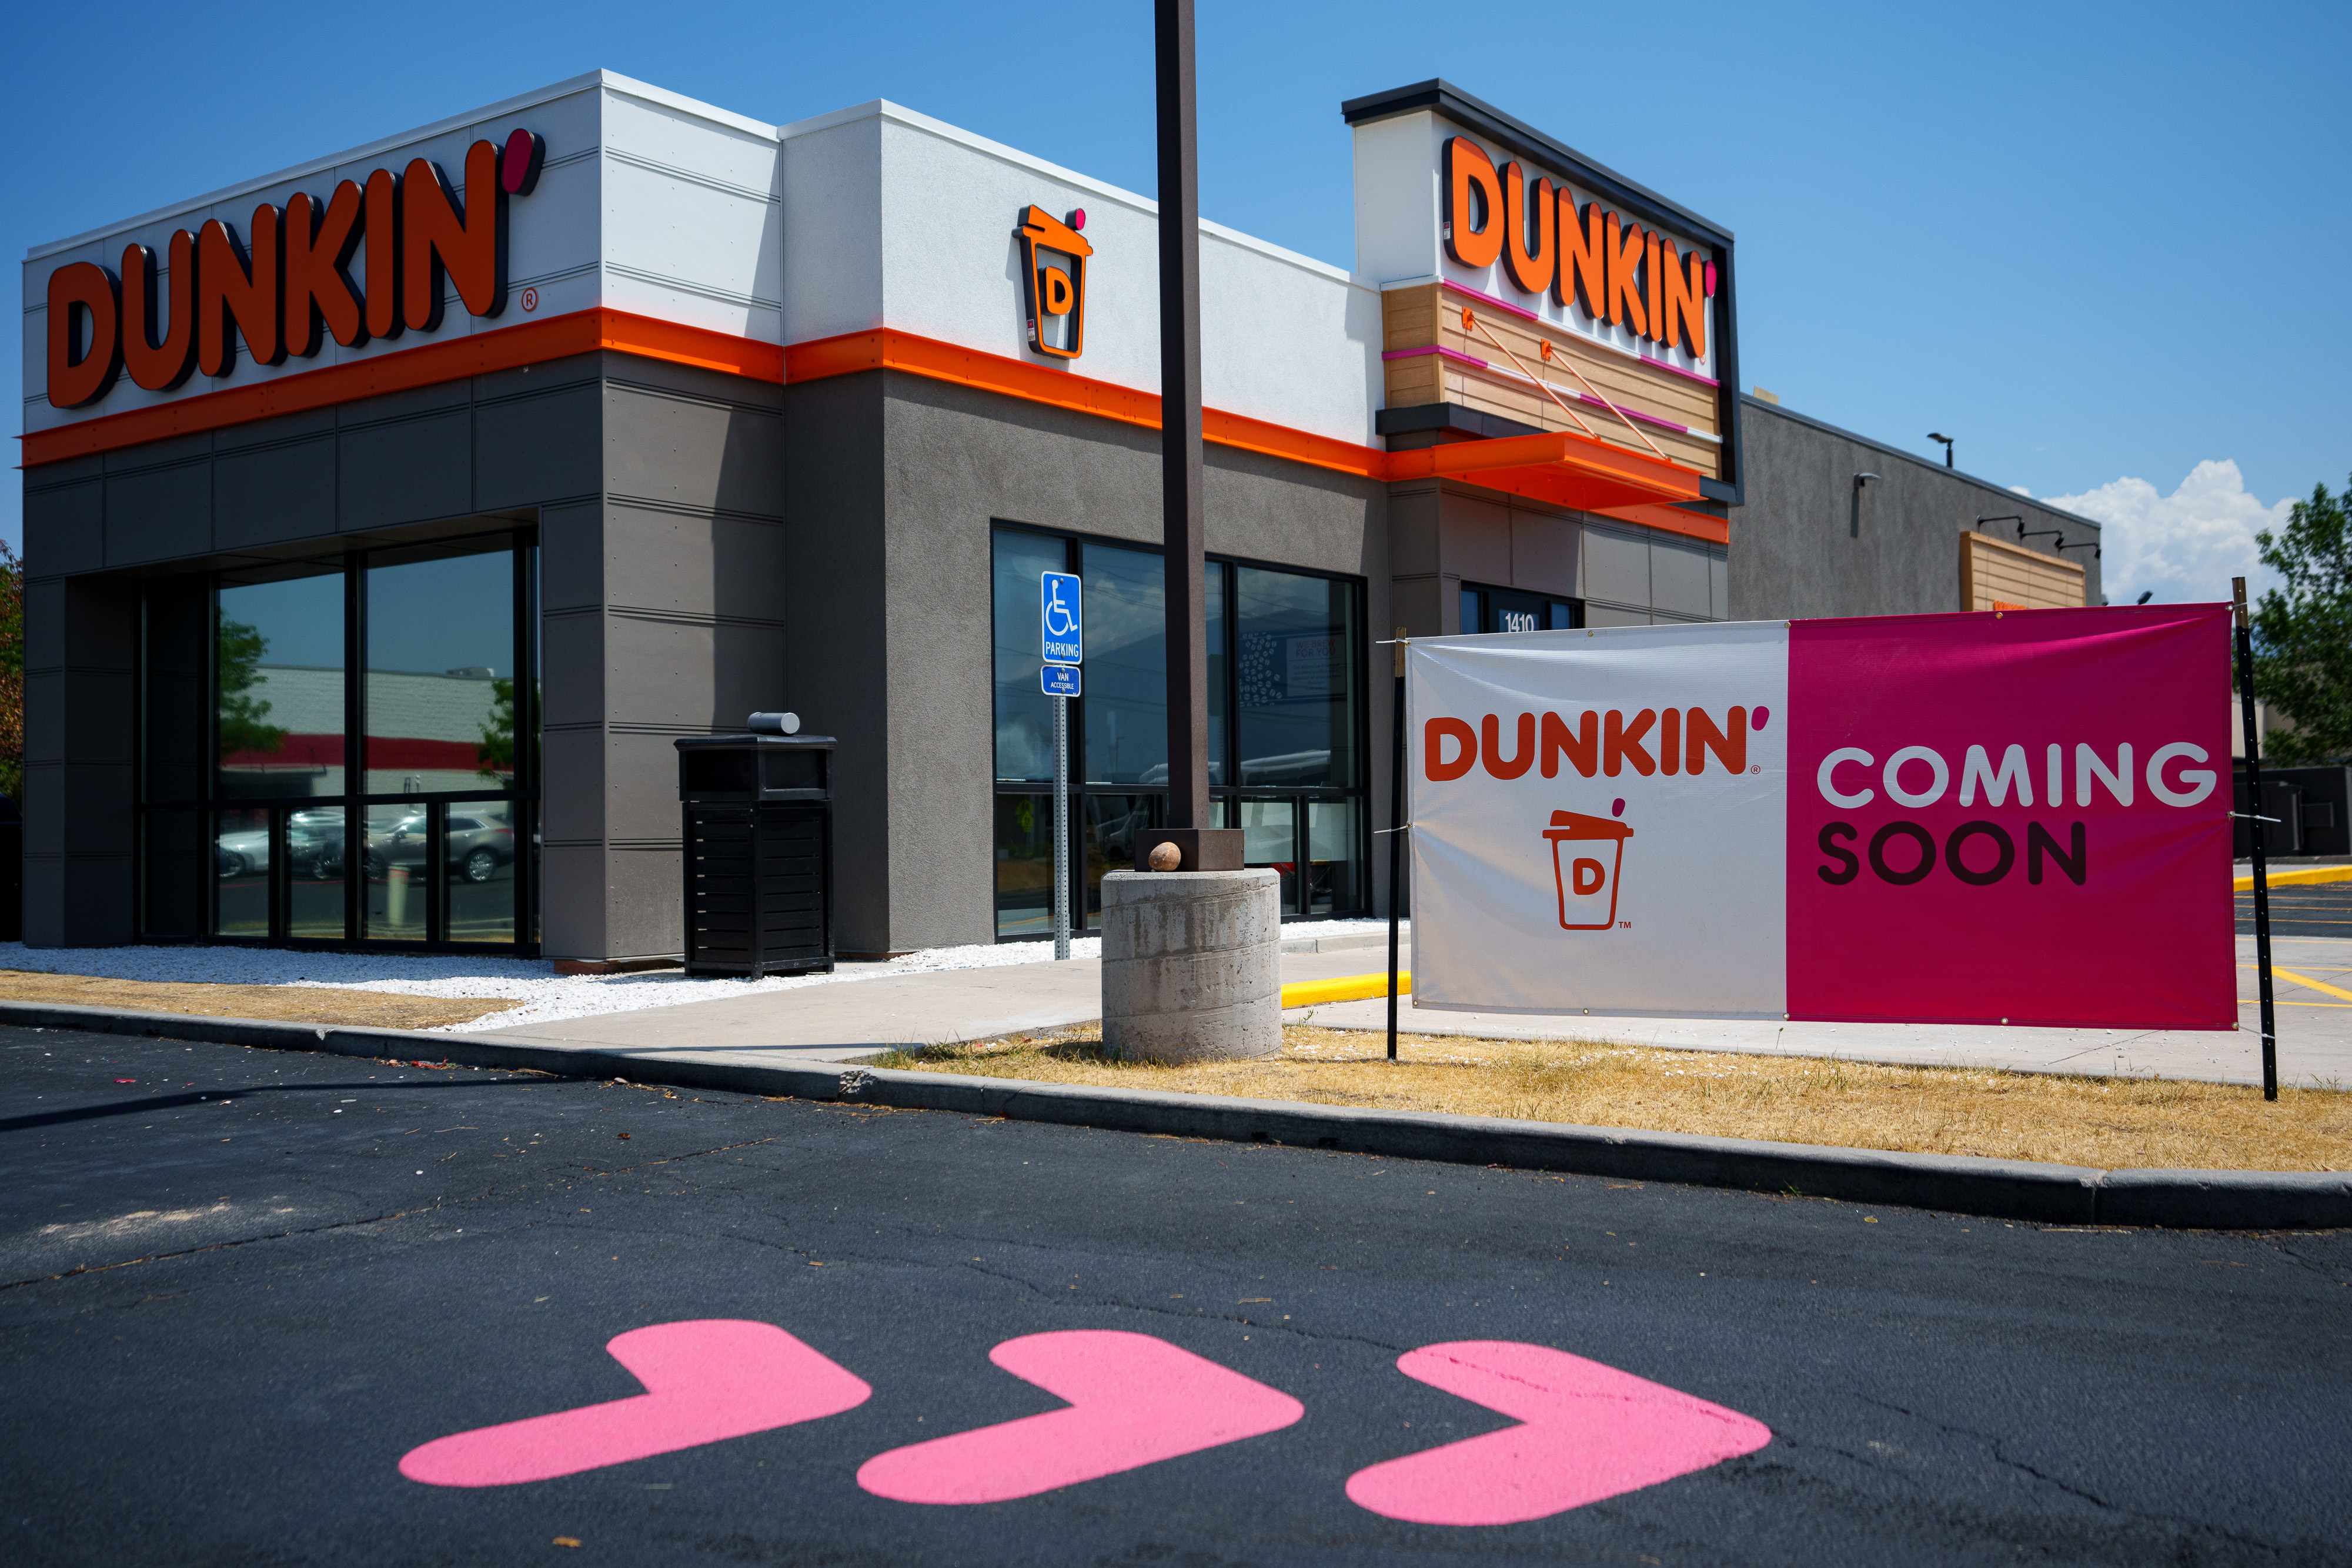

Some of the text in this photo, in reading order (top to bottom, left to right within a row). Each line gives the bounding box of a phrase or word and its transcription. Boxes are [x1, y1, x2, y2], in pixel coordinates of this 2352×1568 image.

[47, 128, 544, 409] DUNKIN'
[1444, 136, 1717, 359] DUNKIN'
[1045, 266, 1073, 315] D
[1505, 613, 1534, 633] 1410
[1045, 641, 1078, 657] PARKING
[1295, 647, 1335, 657] FOR YOU
[1050, 681, 1074, 690] ACCESSIBLE
[1057, 672, 1069, 681] VAN
[1425, 706, 1769, 781] DUNKIN'
[1817, 742, 2217, 808] COMING
[1817, 820, 2086, 885] SOON
[1572, 858, 1605, 895] D
